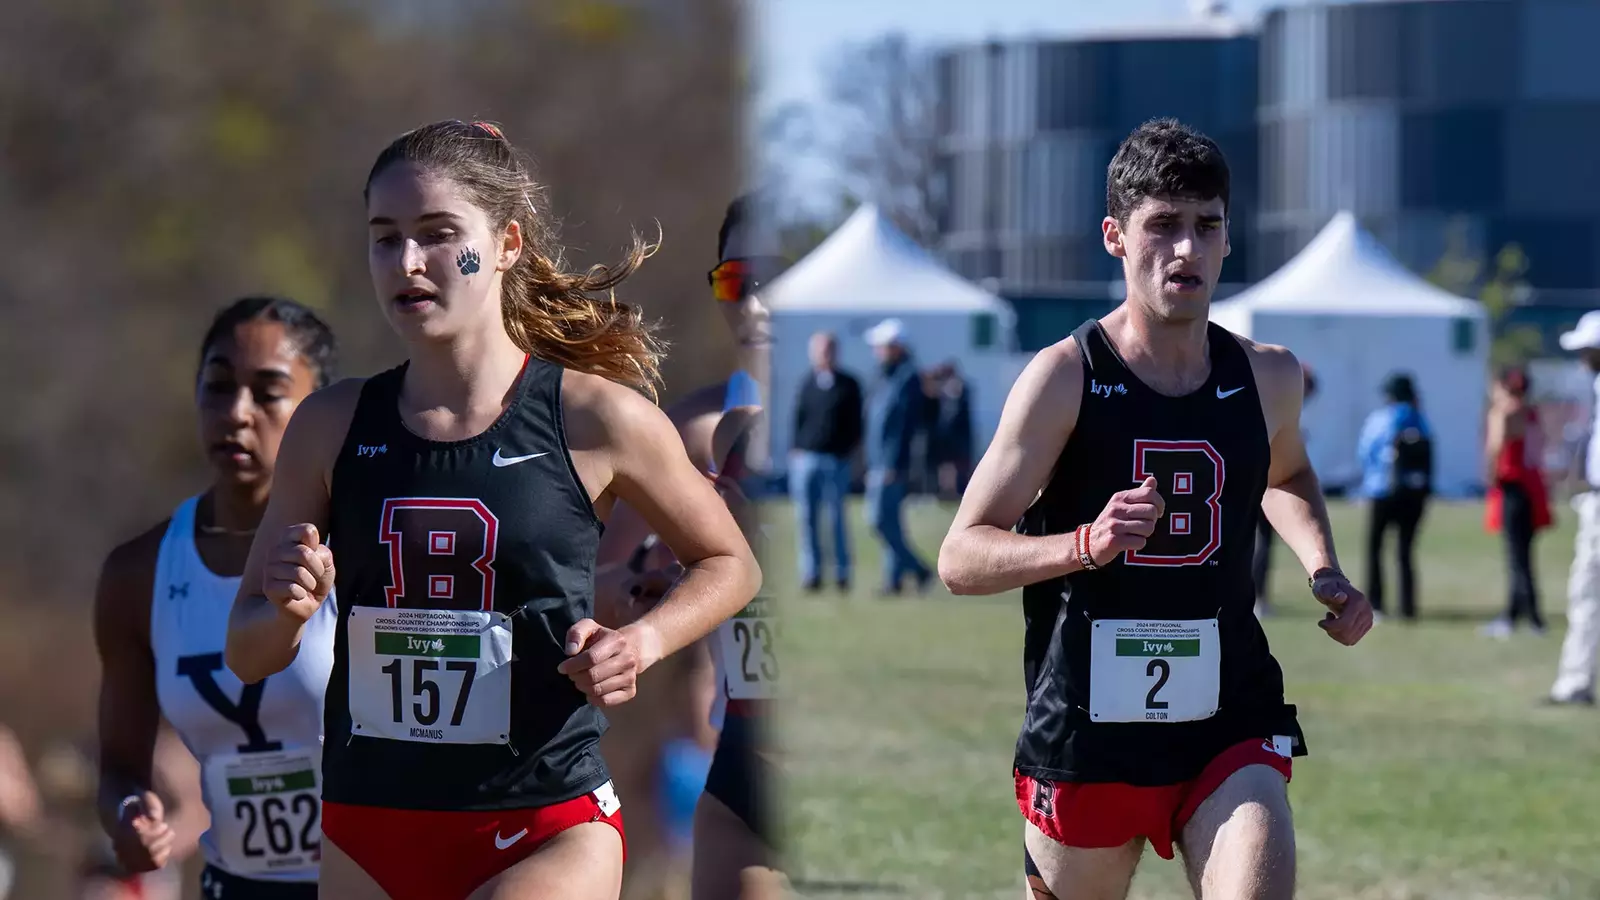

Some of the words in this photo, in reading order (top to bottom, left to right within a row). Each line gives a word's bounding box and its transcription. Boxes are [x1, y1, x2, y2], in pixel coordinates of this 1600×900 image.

[1090, 379, 1112, 398] Ivy
[357, 444, 379, 458] Ivy
[1124, 439, 1225, 567] B
[379, 497, 499, 611] B
[407, 636, 431, 654] Ivy
[734, 621, 782, 682] 23
[1142, 641, 1163, 655] Ivy
[176, 651, 284, 753] Y
[381, 658, 477, 726] 157
[1145, 658, 1170, 709] 2
[409, 727, 443, 740] MCMANUS
[1145, 712, 1168, 720] COLTON
[1031, 778, 1057, 819] B
[235, 793, 321, 857] 262
